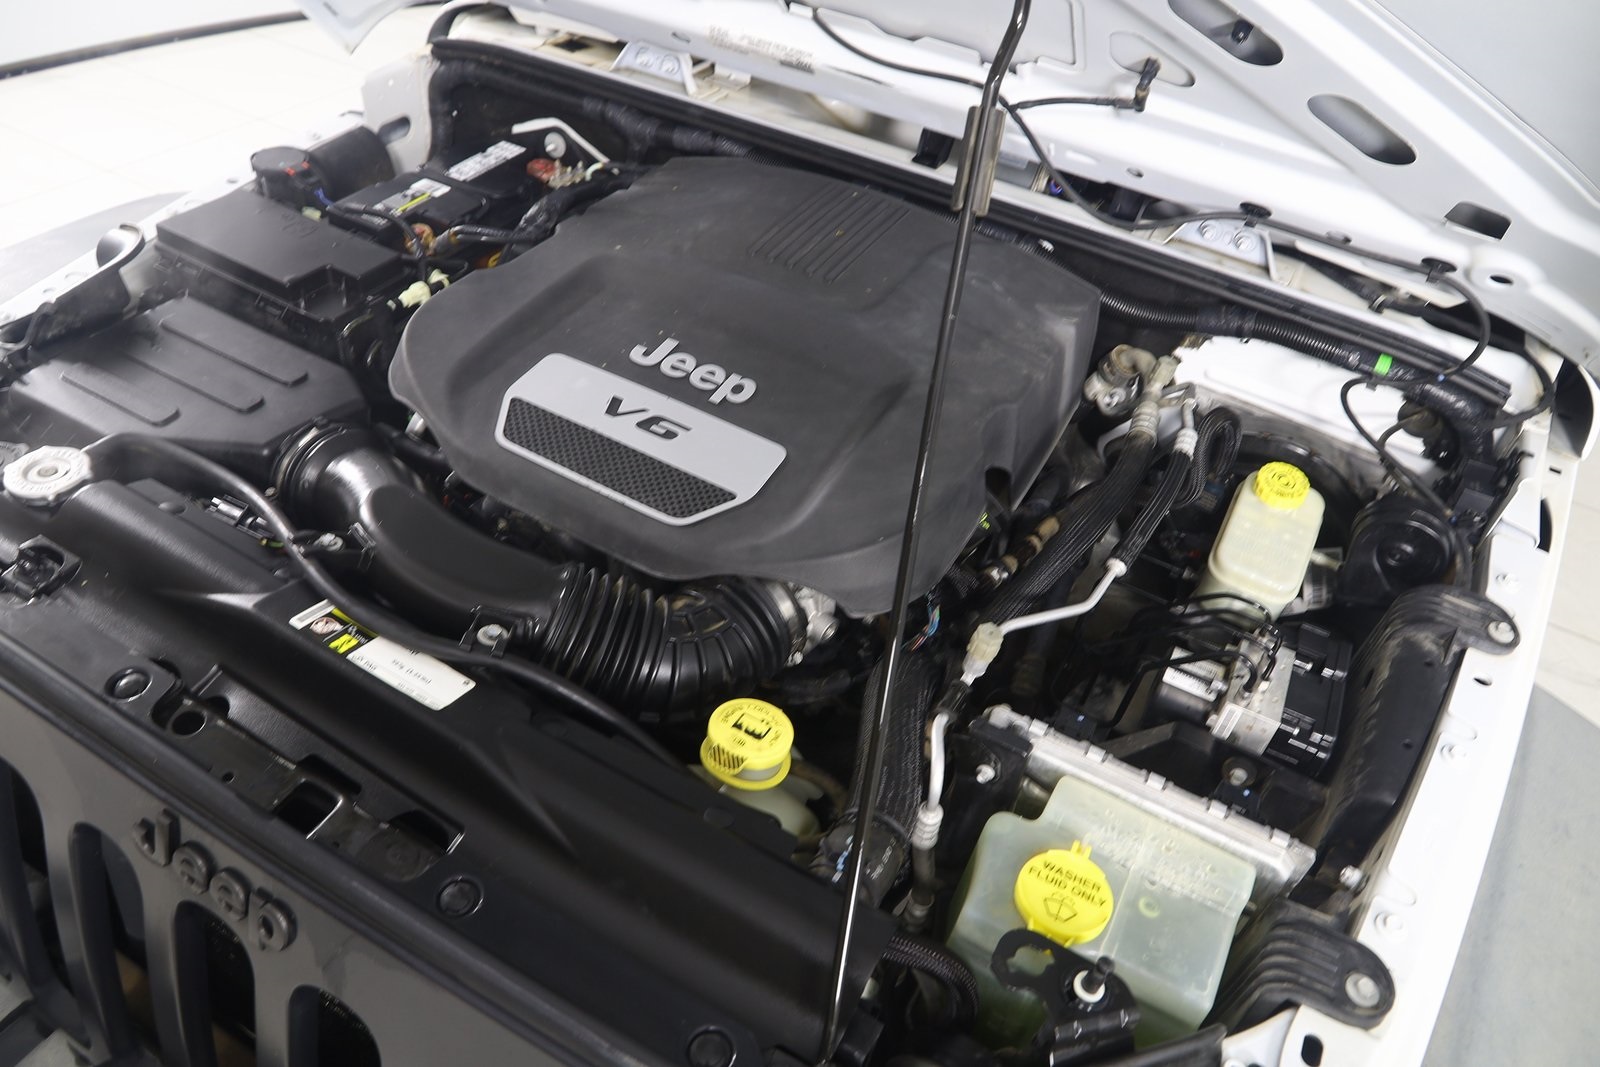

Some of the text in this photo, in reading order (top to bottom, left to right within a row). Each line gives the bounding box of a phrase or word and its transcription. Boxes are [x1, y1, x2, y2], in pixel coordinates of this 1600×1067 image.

[628, 337, 757, 405] Jeep
[604, 395, 693, 441] V6
[132, 808, 298, 951] Jeep
[1028, 865, 1107, 909] FLUID ONLY
[1043, 860, 1102, 893] WASHER
